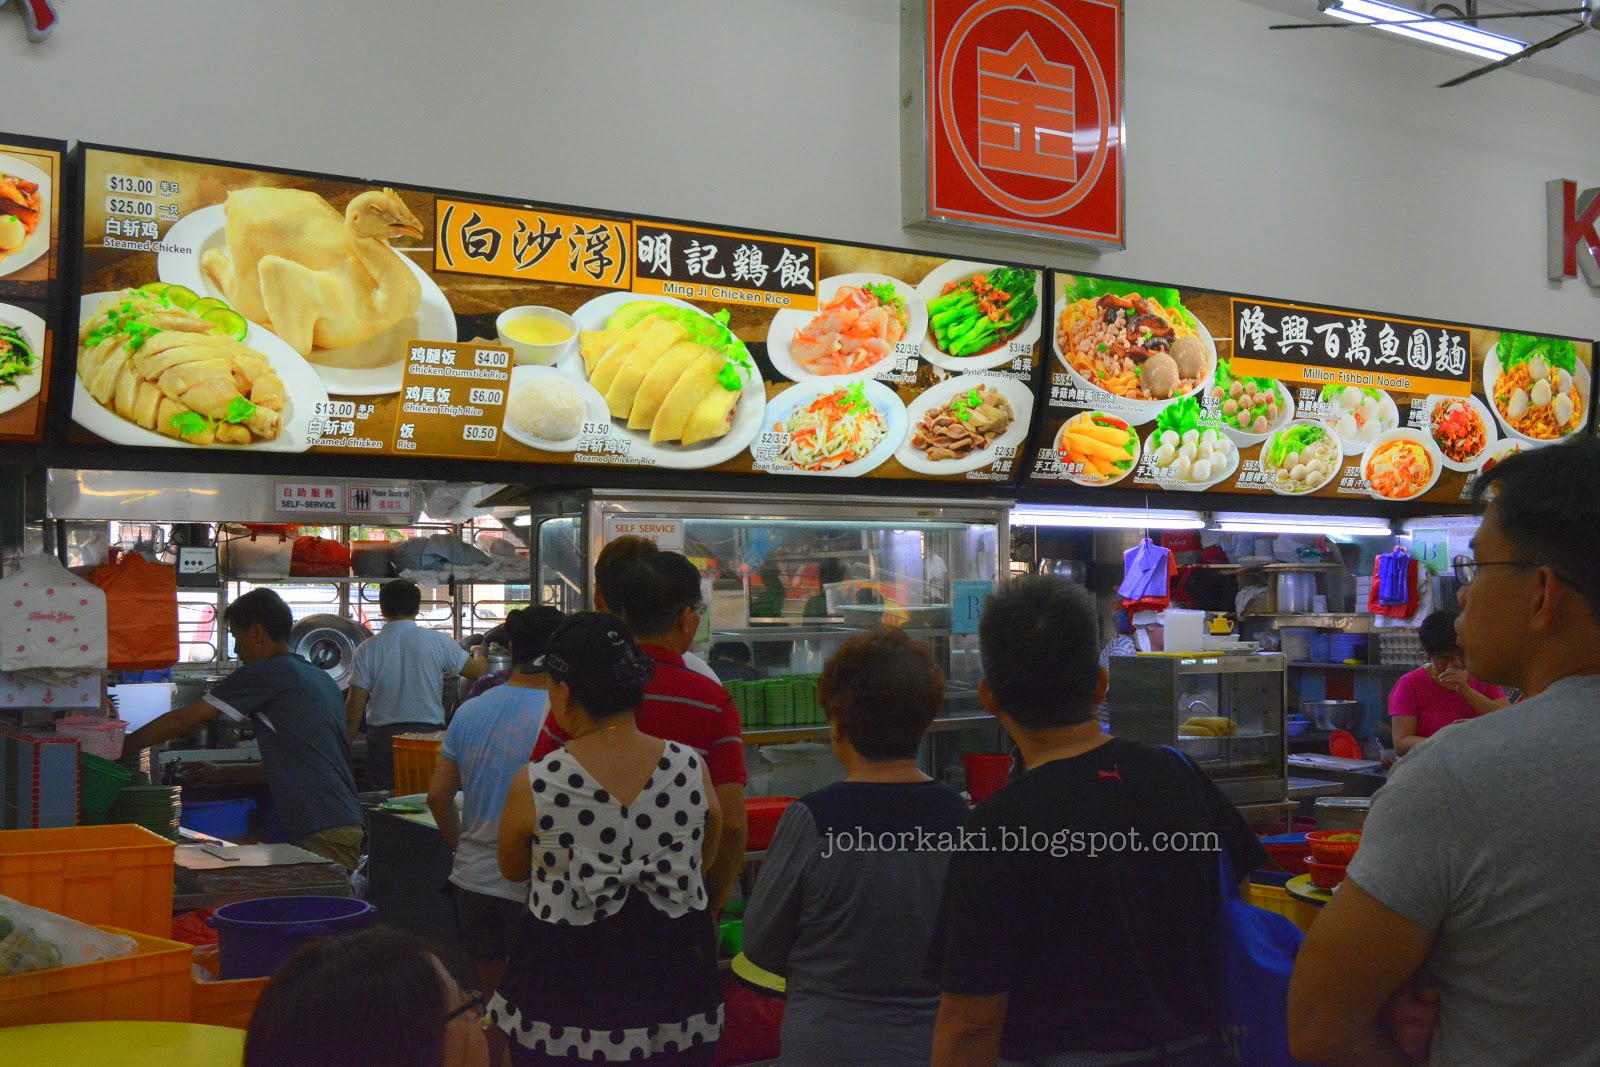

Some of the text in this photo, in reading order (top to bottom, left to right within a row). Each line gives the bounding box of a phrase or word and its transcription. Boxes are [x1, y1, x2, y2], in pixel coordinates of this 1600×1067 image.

[110, 176, 153, 194] $13.00
[160, 181, 180, 193] 半只
[110, 199, 153, 216] $25.00
[159, 204, 180, 215] 一只
[105, 217, 159, 239] 白斩鸡
[104, 237, 192, 255] Steamed Chicken
[663, 281, 791, 306] Ming Ji Chicken Rice
[895, 342, 920, 355] $2/3/5
[1009, 342, 1031, 354] $3/4/5
[410, 346, 457, 366] 鸡腿饭
[477, 351, 506, 365] $4.00
[896, 358, 919, 373] 鸡脚
[1012, 357, 1032, 372] 油菜
[409, 365, 508, 381] Chicken Drumstick Rice
[876, 372, 917, 383] Chicken Feet
[963, 367, 1031, 381] Oyster Sauce Vegetable
[1053, 374, 1072, 384] $3/$4
[1303, 367, 1411, 389] Million Fishball Noodle
[404, 386, 452, 404] 鸡尾饭
[472, 390, 501, 403] $6.00
[315, 402, 353, 416] $13.00
[358, 404, 375, 414] 半只
[403, 403, 484, 417] Chicken Thigh Rice
[307, 419, 355, 437] 白斩鸡
[399, 423, 416, 439] 饭
[466, 426, 494, 439] $0.50
[582, 422, 609, 435] $3.50
[306, 436, 383, 449] Steamed Chicken
[397, 440, 417, 450] Rice
[761, 432, 789, 445] $2/3/5
[576, 437, 632, 455] 白斩鸡饭
[994, 446, 1016, 456] $2/$3
[574, 453, 657, 466] Steamed Chicken Rice
[755, 447, 780, 462] 豆芽
[1038, 449, 1058, 459] $1.20
[752, 462, 795, 473] Bean Sprout
[966, 471, 991, 480] Chicken
[283, 487, 334, 498] 自助服務
[372, 489, 387, 497] Please
[281, 500, 336, 509] SELF-SERVICE
[615, 524, 676, 533] SELF SERVICE
[1422, 542, 1437, 561] B
[967, 595, 981, 620] B
[28, 610, 76, 623] Thank You
